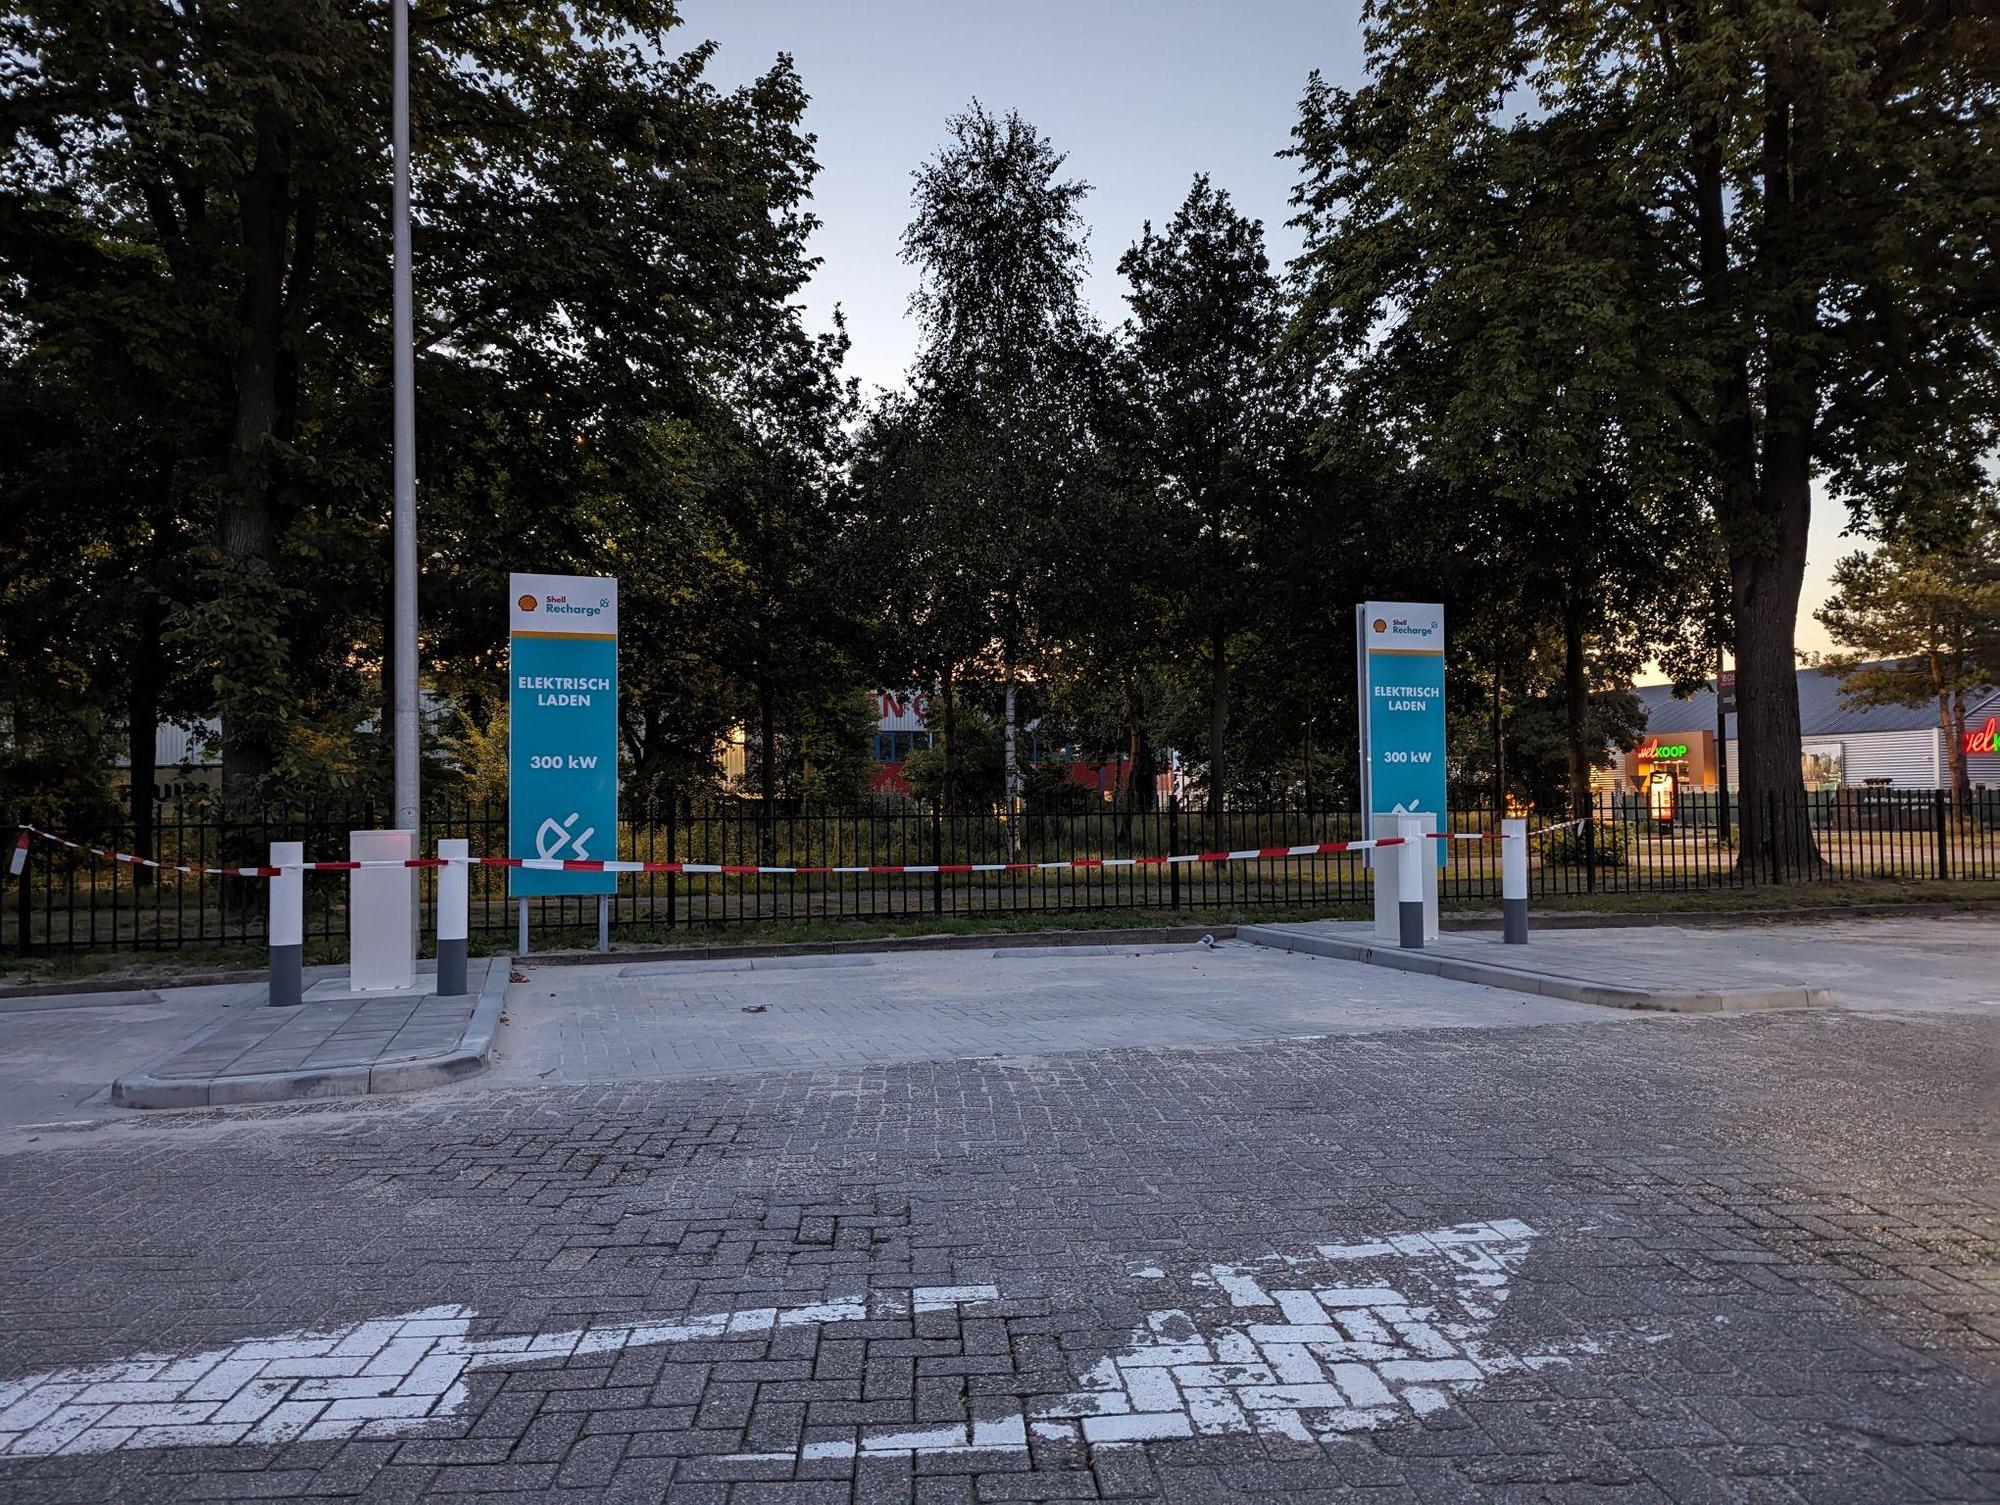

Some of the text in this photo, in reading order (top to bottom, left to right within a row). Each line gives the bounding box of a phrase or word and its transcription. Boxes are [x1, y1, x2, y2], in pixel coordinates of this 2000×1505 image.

[546, 596, 567, 604] Shell
[546, 603, 601, 617] Recharge
[1392, 626, 1433, 637] Recharge
[518, 676, 610, 691] ELEKTRISCH
[1374, 686, 1440, 698] ELEKTRISCH
[537, 693, 591, 707] LADEN
[1388, 700, 1426, 712] LADEN
[530, 754, 598, 770] 300 kW
[1383, 751, 1432, 763] 300 kW
